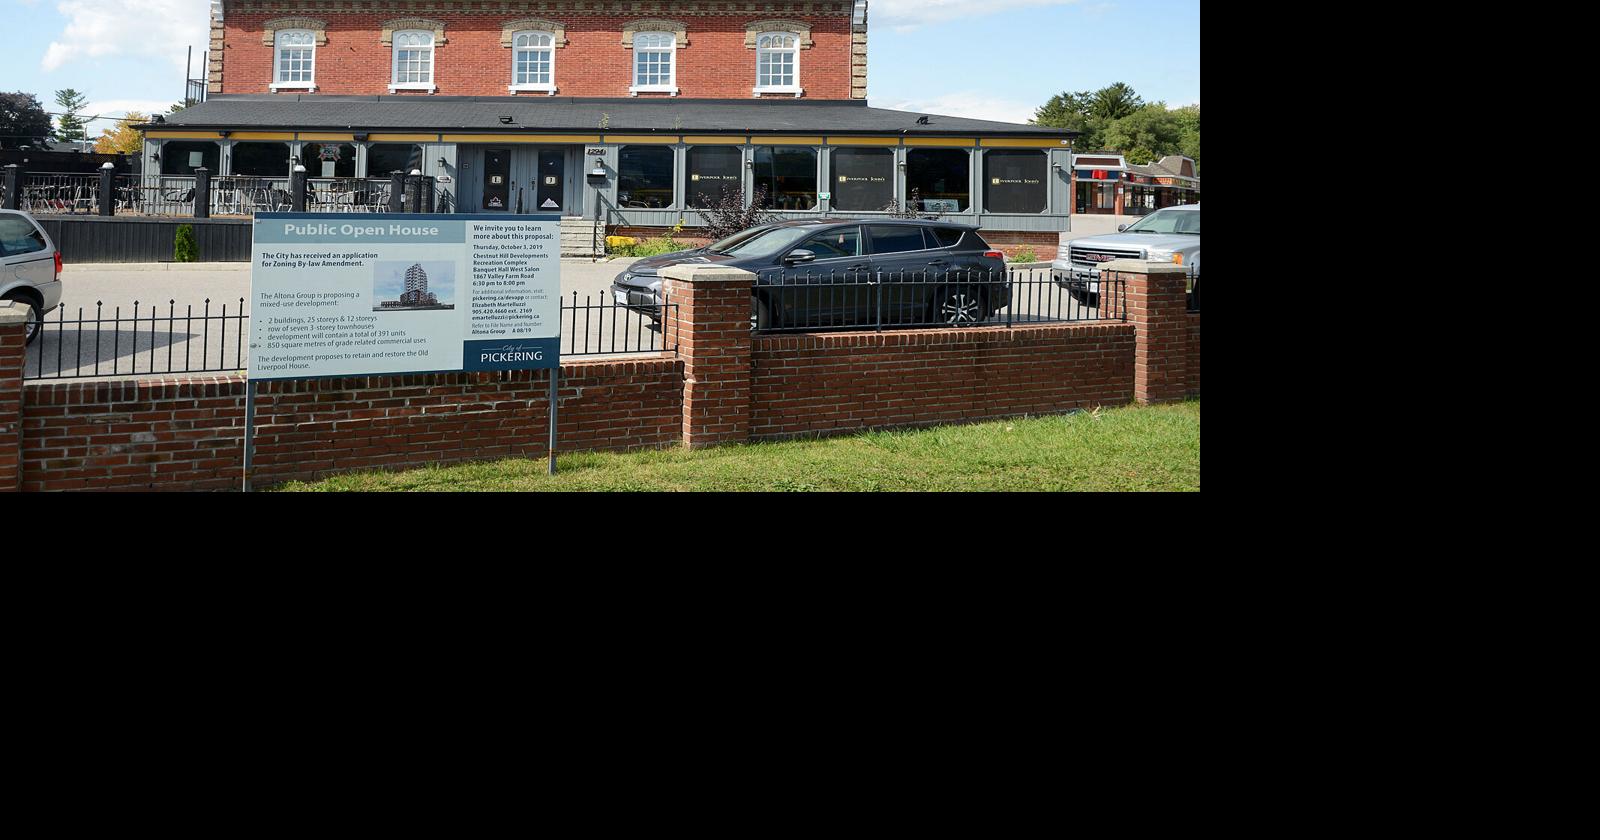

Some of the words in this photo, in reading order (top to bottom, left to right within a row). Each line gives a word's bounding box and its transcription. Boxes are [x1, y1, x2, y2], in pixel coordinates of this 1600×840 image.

[284, 224, 337, 235] Public
[340, 224, 384, 238] Open
[389, 224, 439, 236] House
[276, 252, 289, 260] City
[342, 252, 378, 260] application
[260, 292, 273, 300] The
[296, 292, 316, 300] Group
[323, 292, 355, 300] proposing
[267, 333, 310, 342] development
[335, 340, 353, 348] grade
[377, 337, 412, 345] commercial
[516, 344, 523, 352] of
[258, 355, 270, 363] The
[271, 354, 314, 362] development
[315, 353, 344, 361] proposes
[480, 351, 543, 363] PICKERING
[257, 363, 288, 371] Liverpool
